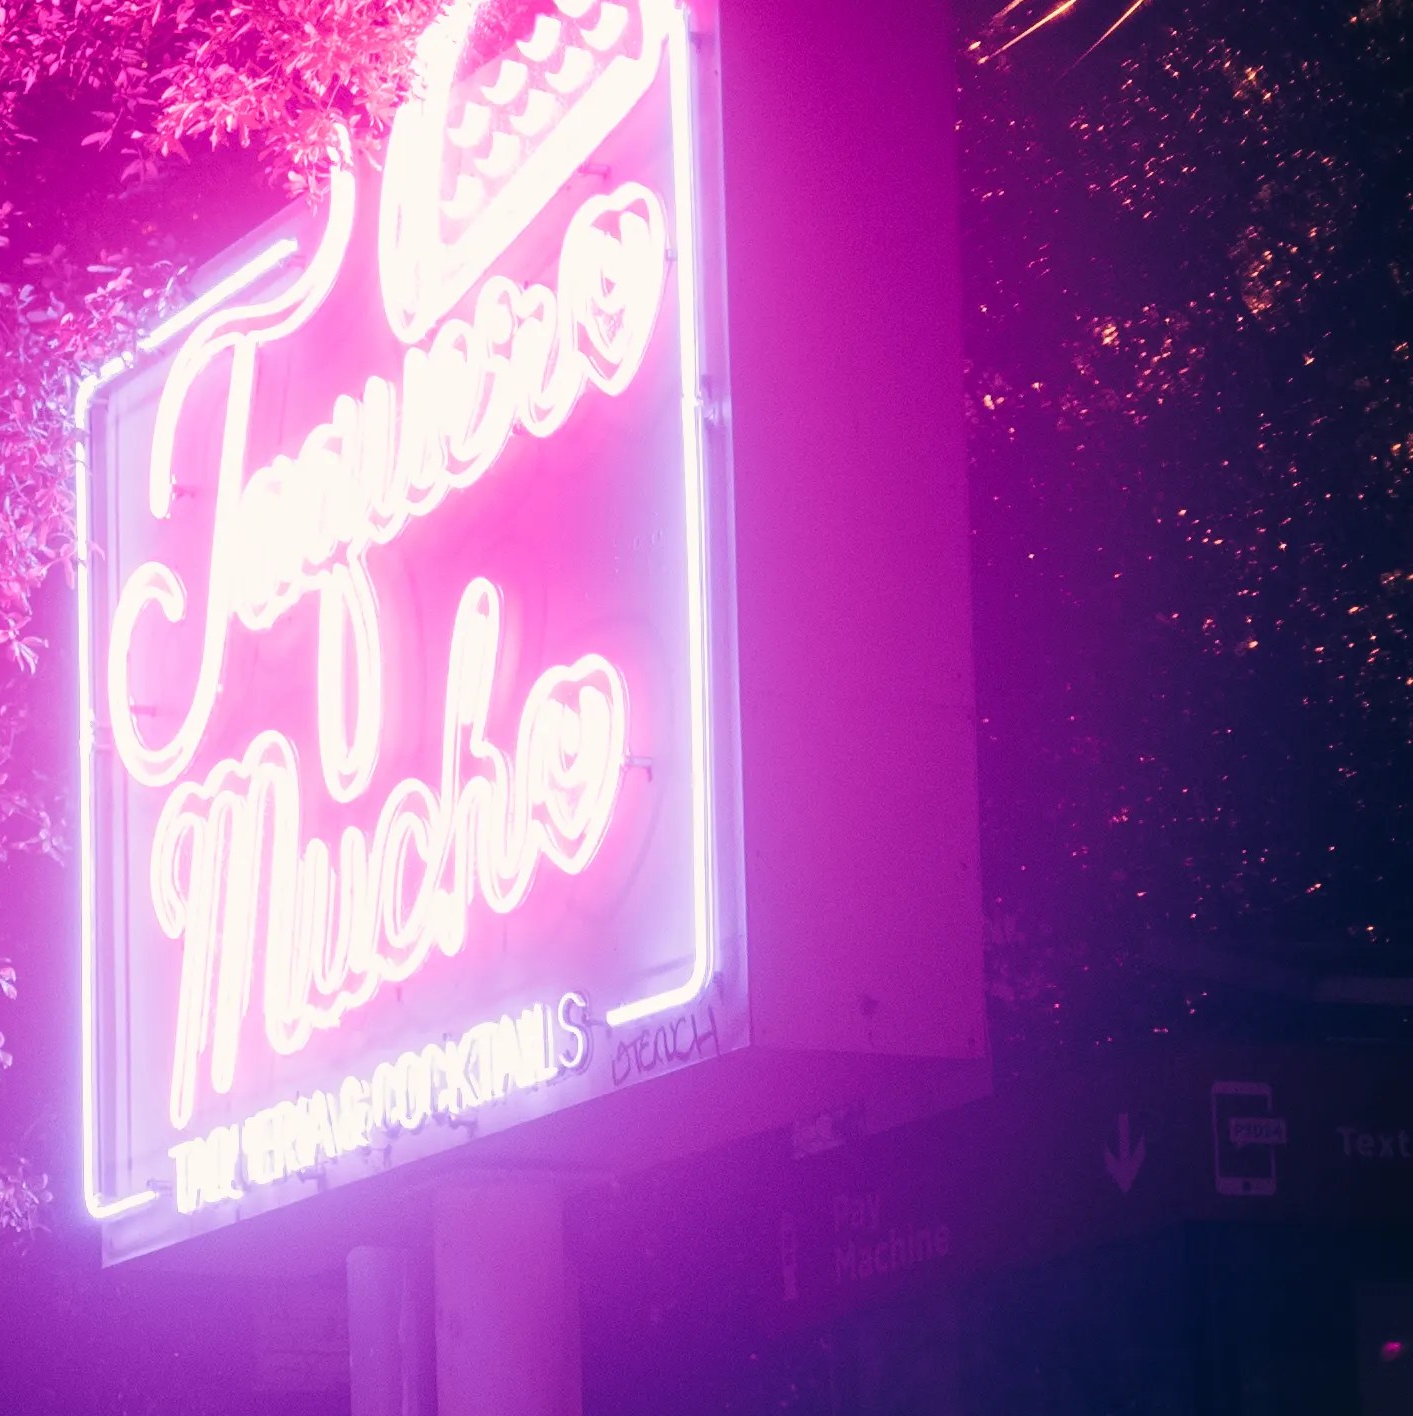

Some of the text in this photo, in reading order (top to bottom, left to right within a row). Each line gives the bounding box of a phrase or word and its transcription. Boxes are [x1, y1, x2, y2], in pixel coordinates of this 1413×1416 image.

[150, 578, 627, 1129] Mucho
[371, 992, 588, 1129] COCKTAILS
[1335, 1126, 1411, 1158] Text
[834, 1222, 951, 1286] Machine
